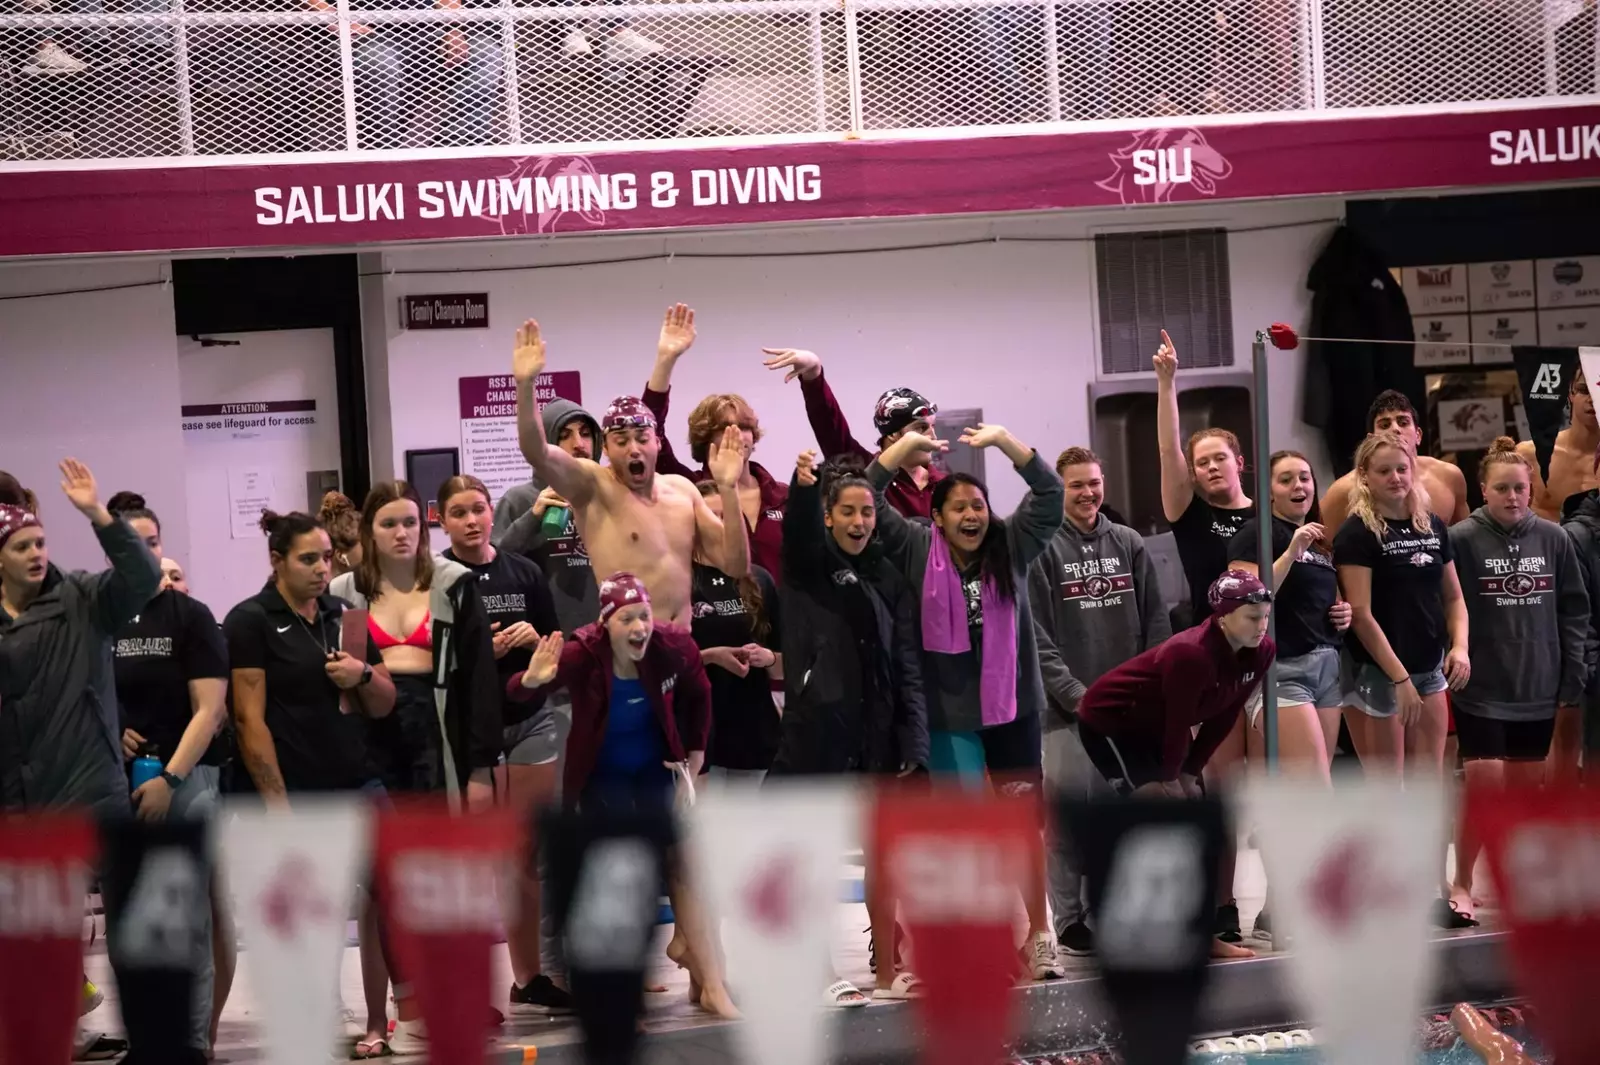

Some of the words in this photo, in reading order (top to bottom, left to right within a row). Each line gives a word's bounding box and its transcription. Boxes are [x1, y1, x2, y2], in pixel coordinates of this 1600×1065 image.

[1489, 124, 1600, 166] SALUK
[1131, 147, 1193, 186] SIU
[254, 182, 405, 226] SALUKI
[417, 172, 638, 218] SWIMMING
[650, 171, 680, 208] &
[691, 164, 822, 207] DIVING
[410, 300, 433, 325] Family
[434, 299, 465, 325] Changing
[465, 298, 485, 319] Room
[488, 377, 506, 389] RSS
[1530, 363, 1561, 393] A3
[486, 391, 517, 403] CHANG
[535, 388, 557, 400] AREA
[220, 403, 269, 414] ATTENTION:
[206, 420, 222, 430] see
[224, 416, 266, 430] lifeguard
[268, 416, 281, 426] for
[284, 415, 317, 426] access.
[1382, 540, 1421, 551] SOUTHERN
[567, 558, 588, 567] SWIM
[1485, 556, 1546, 568] SOUHERN
[1080, 600, 1097, 609] SWIM
[1104, 595, 1122, 606] DIVE
[1496, 597, 1518, 606] SWIM
[1526, 596, 1542, 605] DIVE
[116, 637, 172, 653] SALUKI
